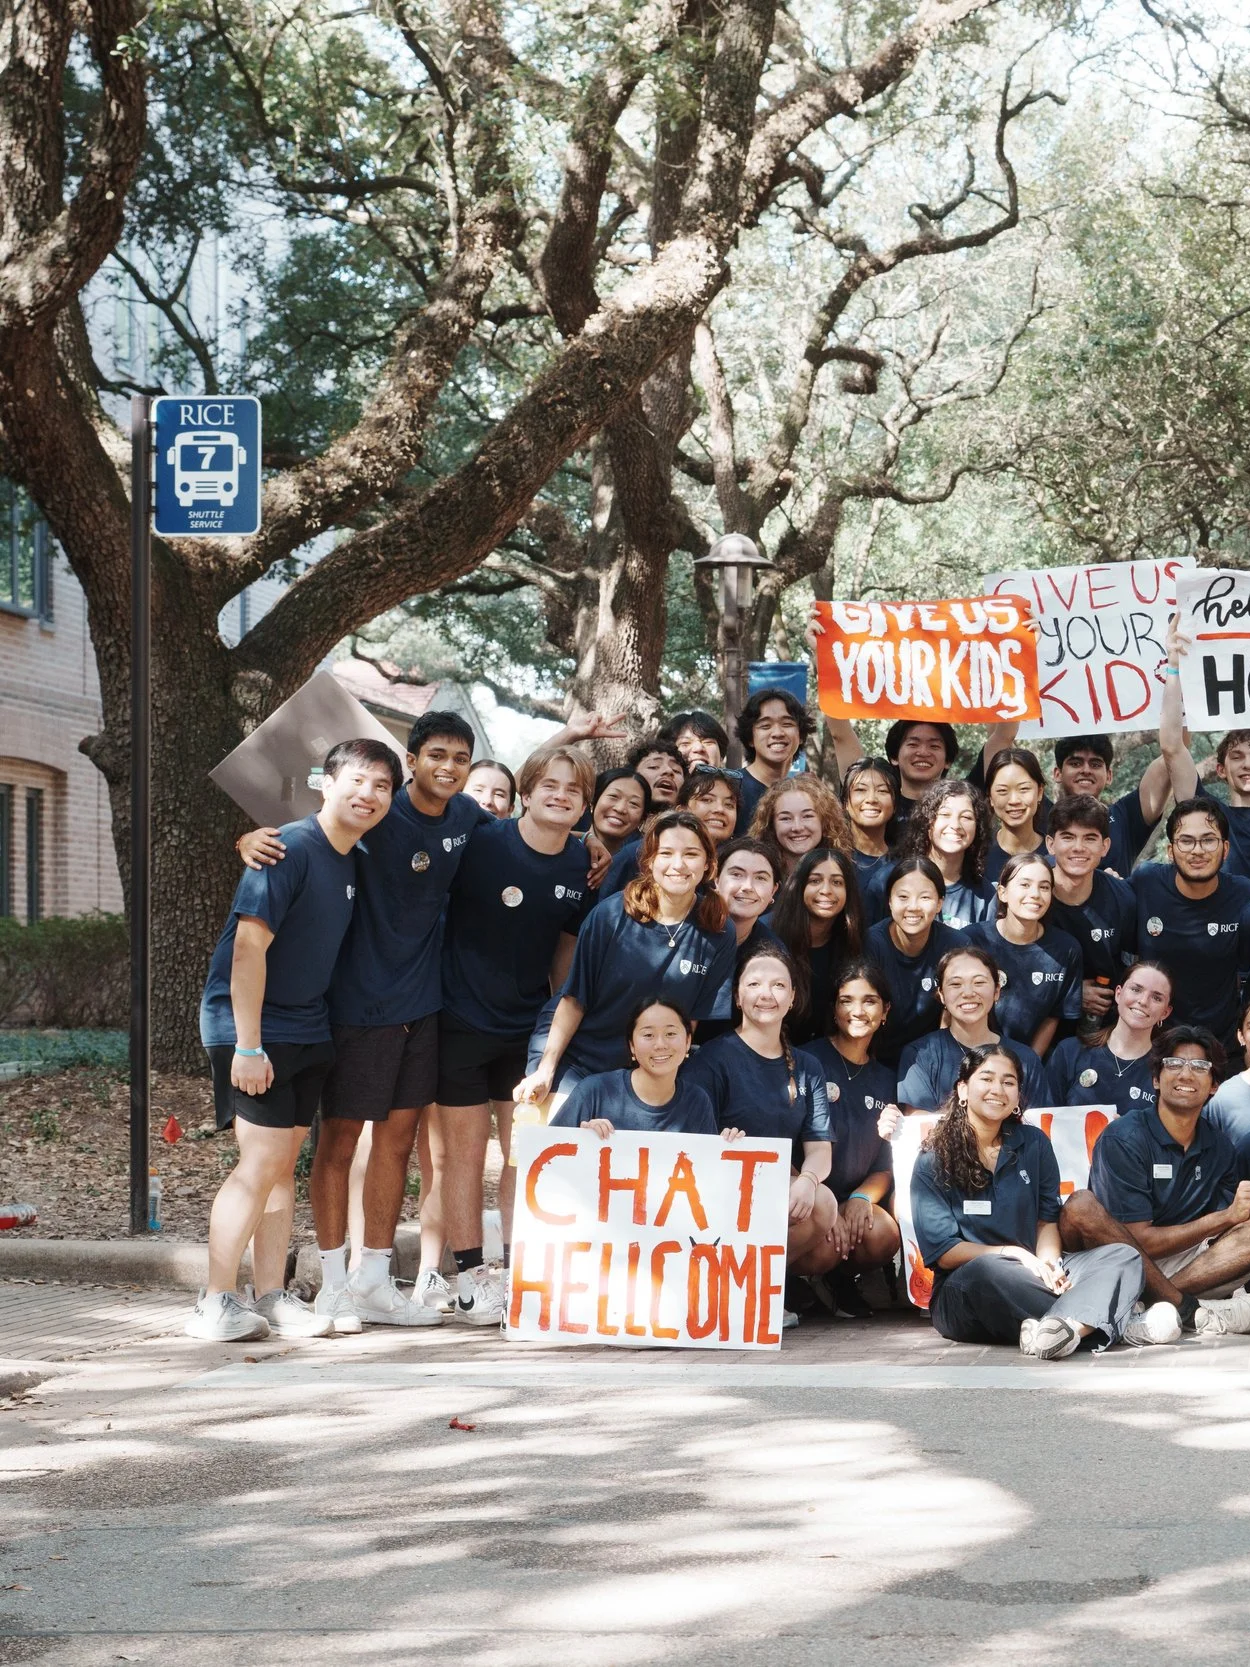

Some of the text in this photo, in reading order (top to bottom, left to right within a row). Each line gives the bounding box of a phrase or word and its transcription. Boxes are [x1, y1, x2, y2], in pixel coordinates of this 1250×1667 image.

[180, 404, 235, 426] RICE
[197, 446, 216, 469] 7
[188, 510, 224, 519] SHUTTLE
[190, 520, 223, 529] SERVICE
[831, 599, 1020, 638] GIVE US
[1038, 612, 1167, 667] YOUR
[832, 638, 1028, 720] YOUR KIDS
[453, 833, 467, 848] RICE
[566, 888, 583, 901] RICE
[1220, 922, 1239, 934] RICE
[1045, 972, 1064, 982] RICE
[1142, 1091, 1156, 1103] RIC
[525, 1143, 780, 1232] CHAT
[509, 1239, 785, 1344] HELLCOME
